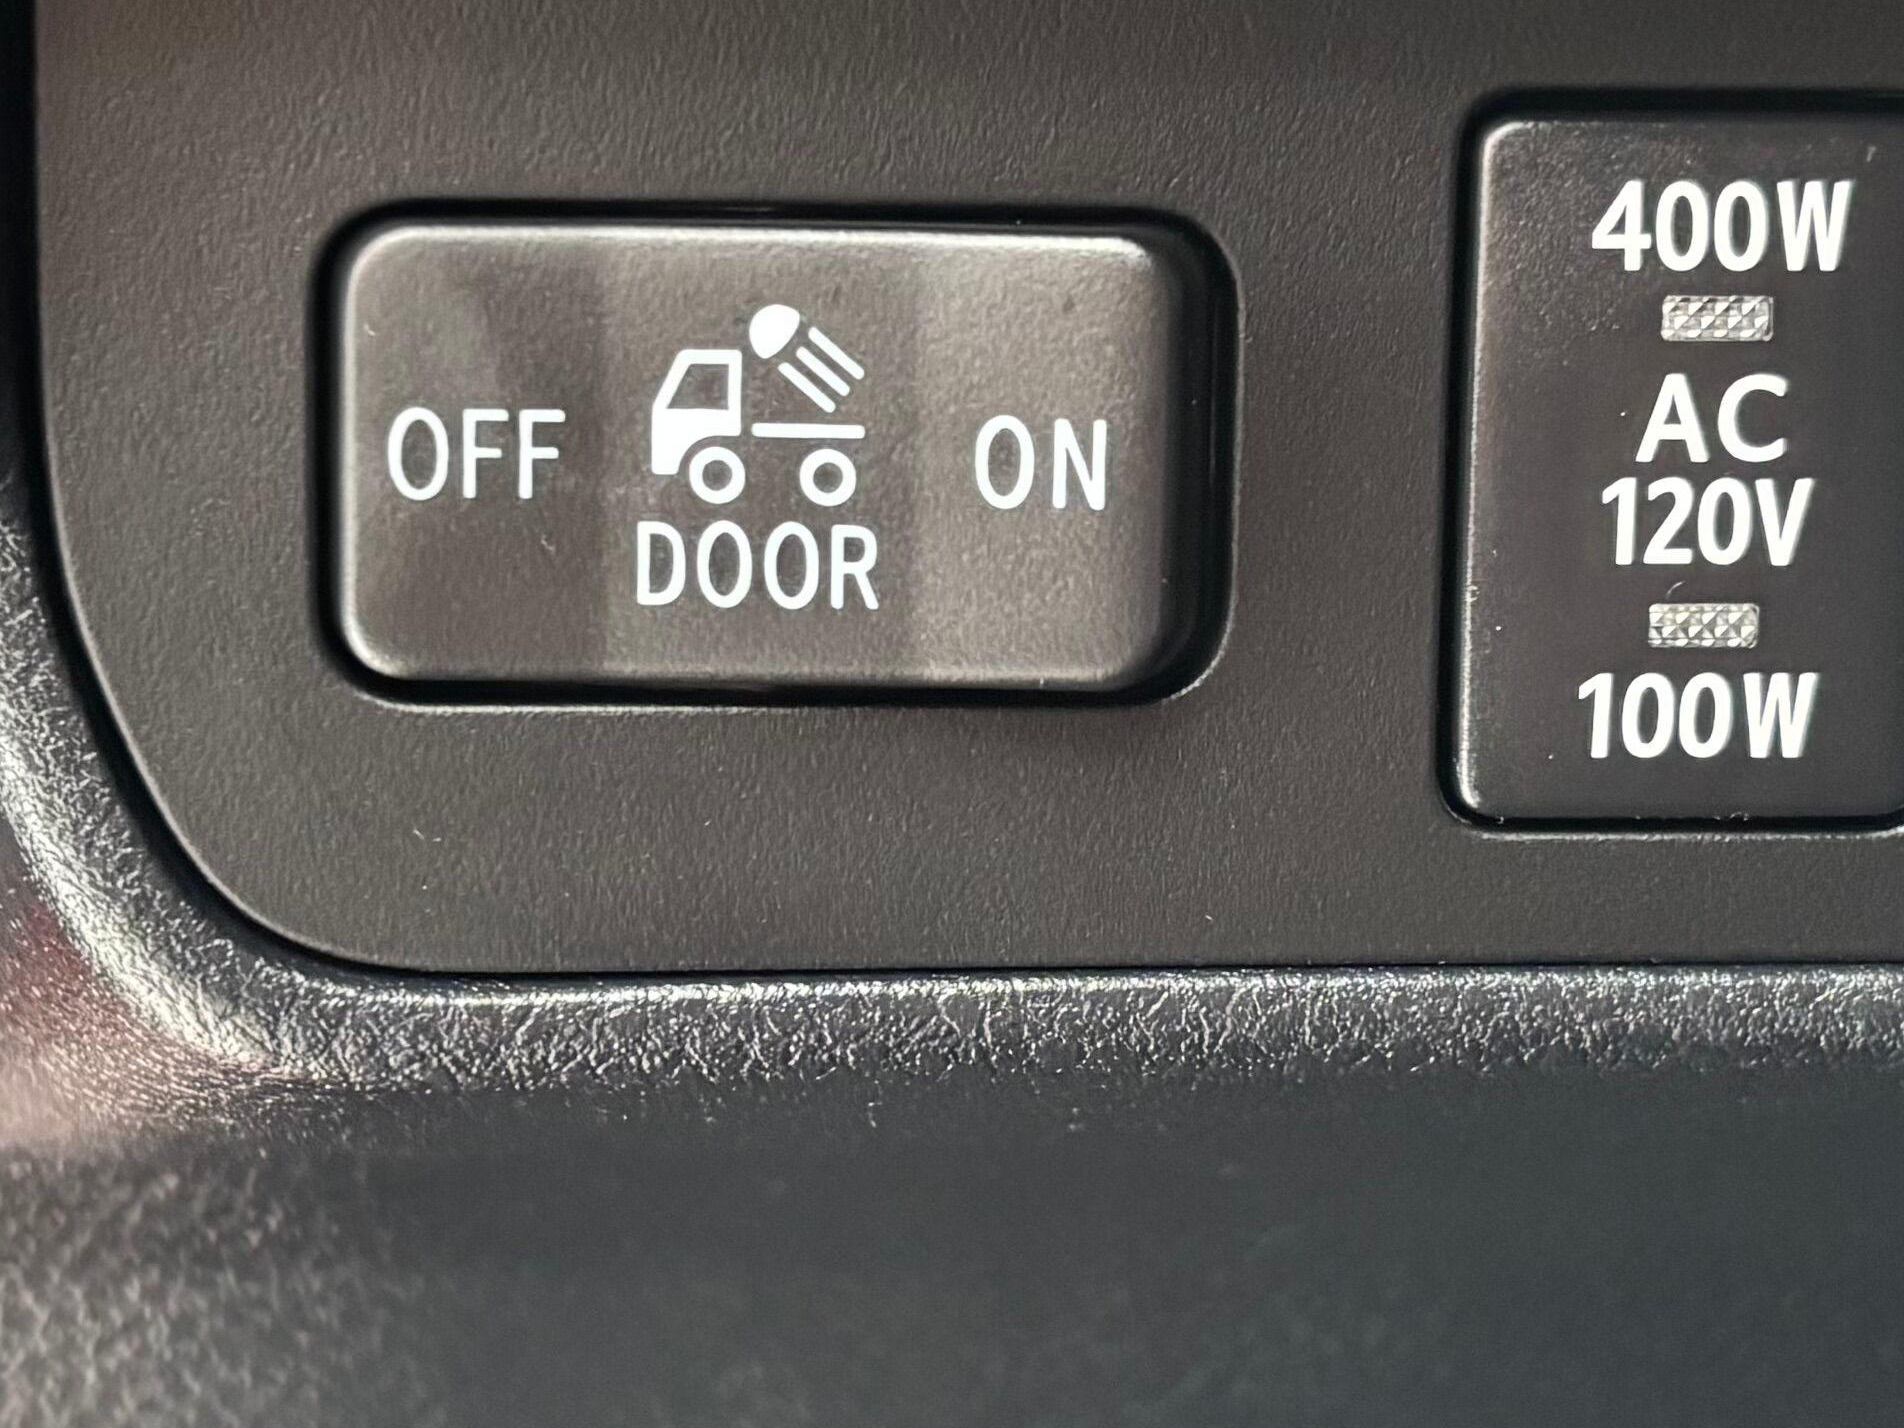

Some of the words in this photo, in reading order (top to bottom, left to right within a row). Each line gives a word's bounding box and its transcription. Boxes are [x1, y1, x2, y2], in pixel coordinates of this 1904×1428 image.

[1590, 178, 1854, 273] 400W
[385, 404, 567, 502] OFF
[972, 412, 1109, 515] ON
[1634, 371, 1789, 464] AC
[634, 518, 881, 612] DOOR
[1600, 475, 1816, 568] 120V
[1577, 671, 1820, 760] 100W
